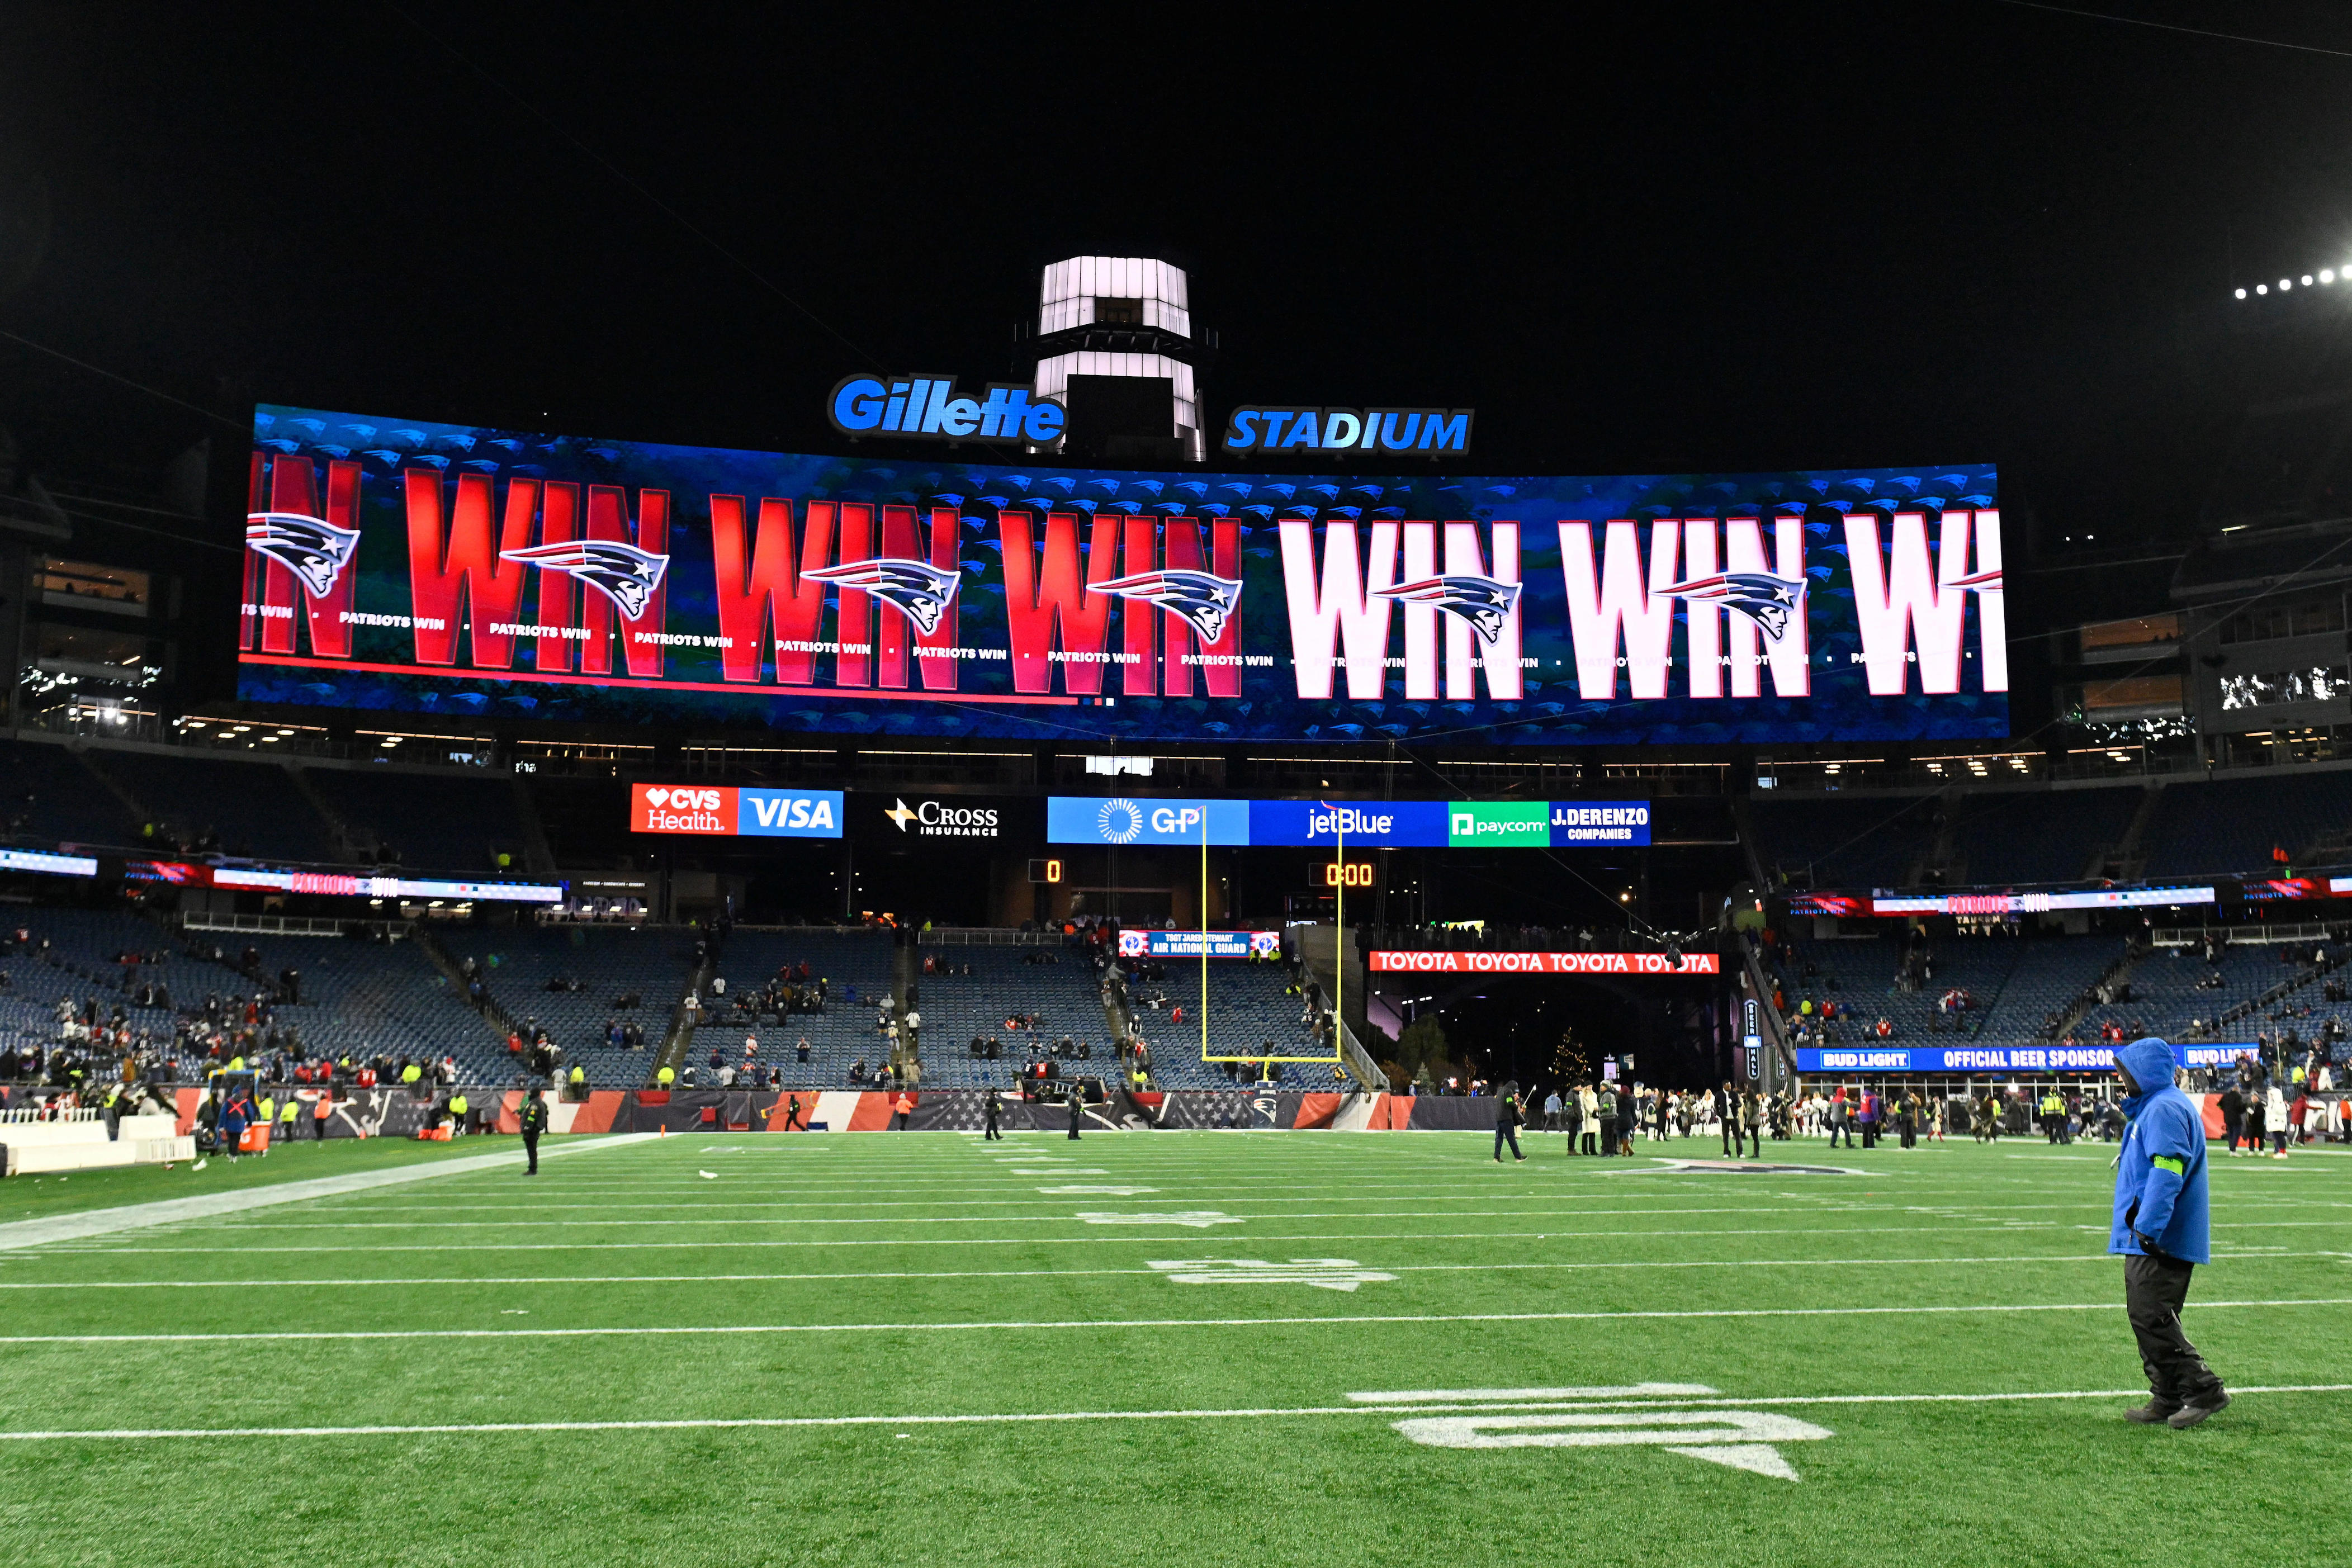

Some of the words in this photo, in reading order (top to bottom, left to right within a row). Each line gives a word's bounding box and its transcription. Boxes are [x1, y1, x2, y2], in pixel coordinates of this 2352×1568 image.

[835, 380, 1066, 440] Gillette
[1228, 410, 1469, 450] STADIUM
[405, 467, 670, 677] WIN
[710, 493, 960, 690] WIN
[259, 605, 293, 618] WIN
[998, 510, 1241, 697] WIN
[1278, 519, 1523, 699] WIN
[1558, 515, 1811, 699] WIN
[339, 612, 411, 628] PATRIOTS
[413, 617, 445, 631] WIN
[490, 622, 559, 638] PATRIOTS
[561, 627, 591, 640] WIN
[635, 632, 701, 647] PATRIOTS
[703, 636, 733, 648] WIN
[775, 640, 840, 654] PATRIOTS
[842, 643, 871, 655] WIN
[912, 646, 976, 660] PATRIOTS
[978, 649, 1007, 660] WIN
[1047, 651, 1110, 664] PATRIOTS
[1112, 652, 1140, 665] WIN
[1181, 653, 1243, 666] PATRIOTS
[1245, 656, 1273, 666] WIN
[670, 789, 721, 811] CVS
[747, 798, 834, 828] VISA
[1551, 808, 1648, 826] J.DERENZO
[920, 826, 998, 837] INSURANCE
[1307, 808, 1392, 839] jetBlue
[1476, 820, 1543, 835] paycom
[1568, 828, 1632, 840] COMPANIES
[1047, 860, 1061, 883] 0
[1327, 864, 1372, 885] 0:00
[291, 873, 356, 896] PATRIOTS
[371, 877, 399, 897] WIN
[1948, 894, 2009, 914] PATRIOTS
[2023, 893, 2050, 912] WIN
[1165, 934, 1182, 942] TSGT
[1182, 934, 1203, 942] JARED
[1205, 934, 1234, 942] STEWART
[1153, 942, 1169, 953] AIR
[1171, 942, 1213, 954] NATIONAL
[1215, 943, 1247, 954] GUARD
[1378, 952, 1458, 970] TOYOTA
[1464, 953, 1544, 970] TOYOTA
[1550, 954, 1629, 972] TOYOTA
[1635, 954, 1712, 972] TOYOTA
[1823, 1053, 1858, 1067] BUD
[1859, 1053, 1908, 1067] LIGHT
[1944, 1050, 2008, 1067] OFFICIAL
[2010, 1050, 2046, 1067] BEER
[2048, 1049, 2114, 1067] SPONSOR
[2187, 1049, 2220, 1064] BUD
